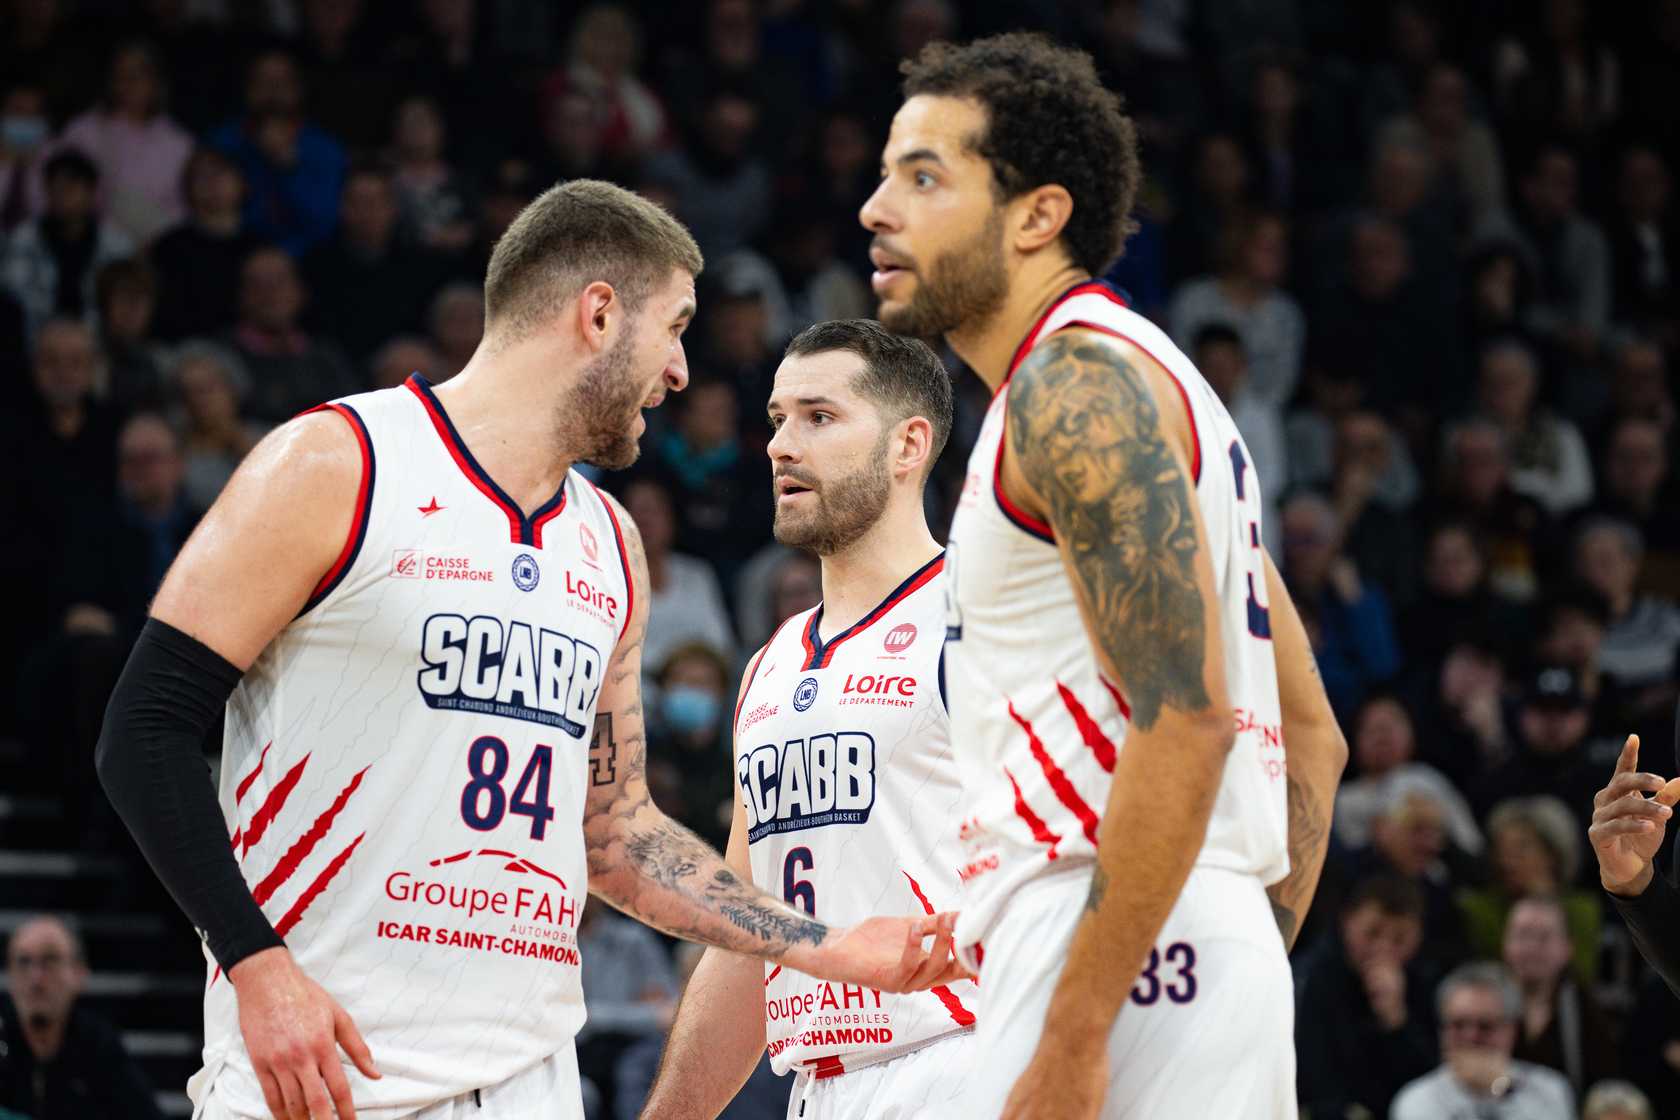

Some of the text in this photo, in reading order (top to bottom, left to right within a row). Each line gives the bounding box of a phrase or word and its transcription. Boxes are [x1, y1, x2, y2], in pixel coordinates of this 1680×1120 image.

[426, 556, 470, 569] CAISSE
[566, 570, 617, 619] Loire
[417, 613, 601, 731] SCABB
[842, 674, 917, 697] Loire
[460, 735, 555, 841] 84
[738, 731, 876, 832] SCABB
[834, 813, 861, 822] BASKET
[385, 872, 581, 929] Groupe FAH
[783, 846, 816, 918] 6
[377, 921, 431, 943] ICAR
[510, 924, 577, 945] AUTOMOBIL
[1129, 941, 1198, 1007] 33
[766, 993, 814, 1024] oupe
